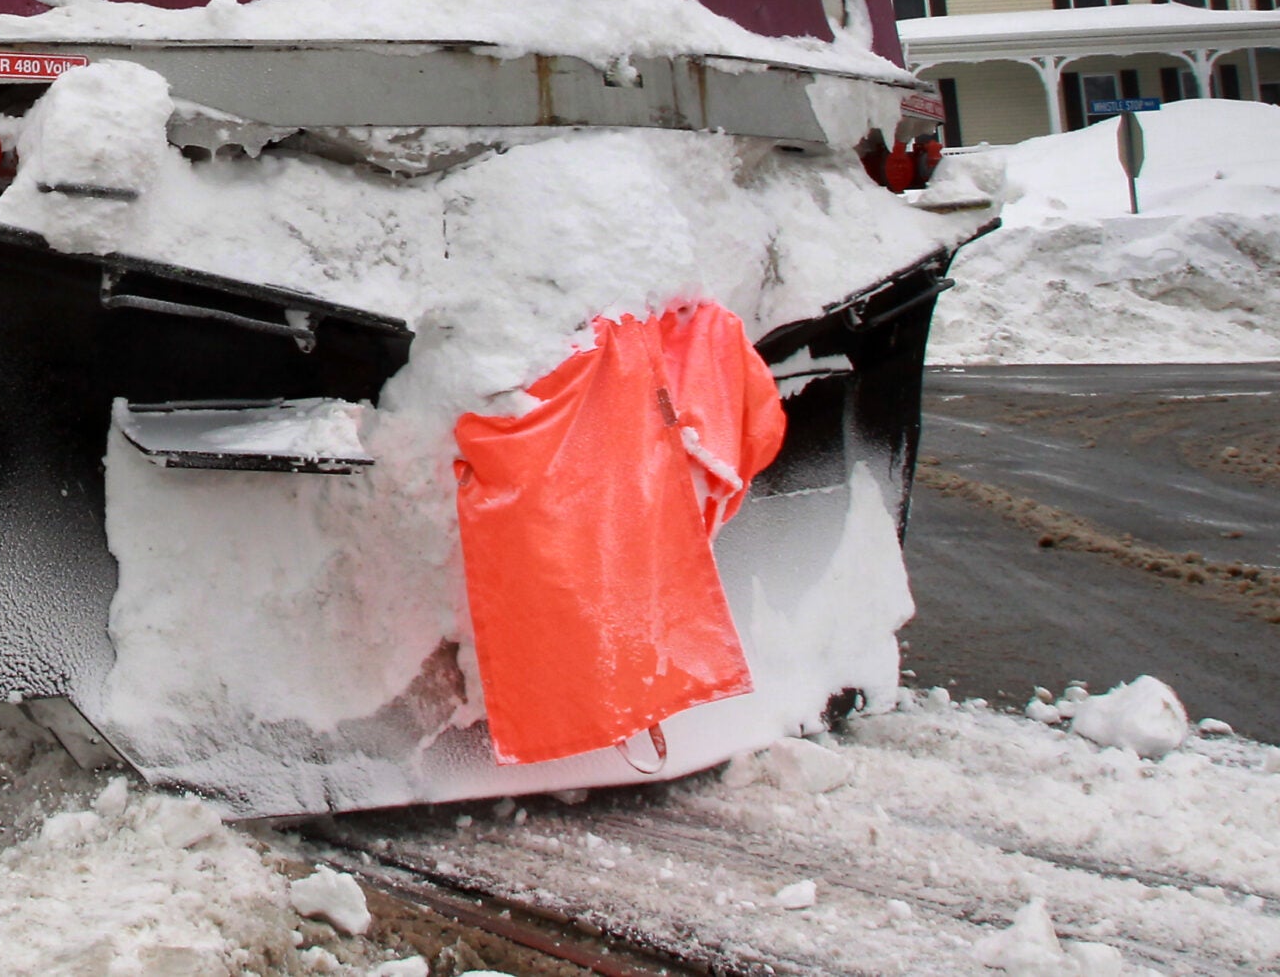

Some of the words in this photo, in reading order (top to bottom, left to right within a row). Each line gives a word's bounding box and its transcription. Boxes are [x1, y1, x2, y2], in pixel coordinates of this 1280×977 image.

[15, 60, 40, 73] 480
[1093, 101, 1123, 112] WHISTLE
[1125, 100, 1144, 111] STOP
